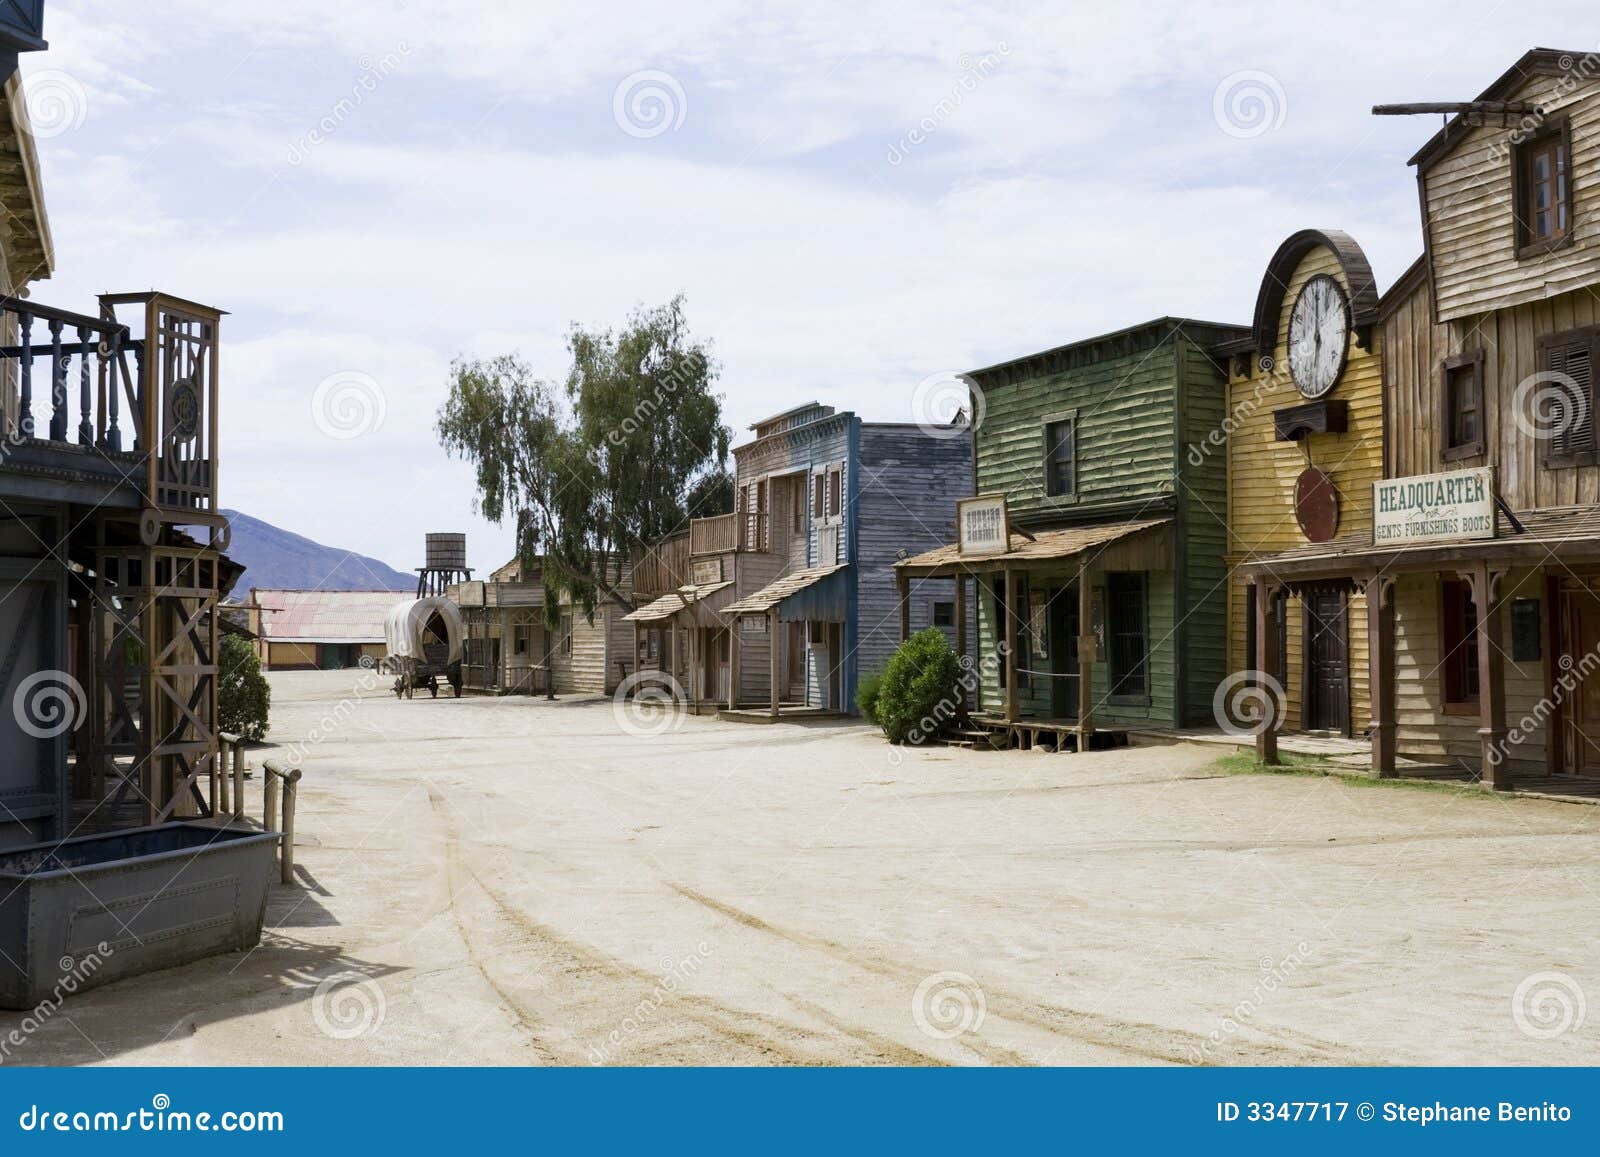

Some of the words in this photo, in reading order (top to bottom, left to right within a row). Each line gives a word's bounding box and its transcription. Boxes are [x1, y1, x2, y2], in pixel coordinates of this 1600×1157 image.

[1379, 476, 1485, 512] HEADQUARTER
[1376, 523, 1402, 539] GENTS
[1405, 518, 1458, 537] FURNISHINGS
[1462, 515, 1491, 532] BOOTS
